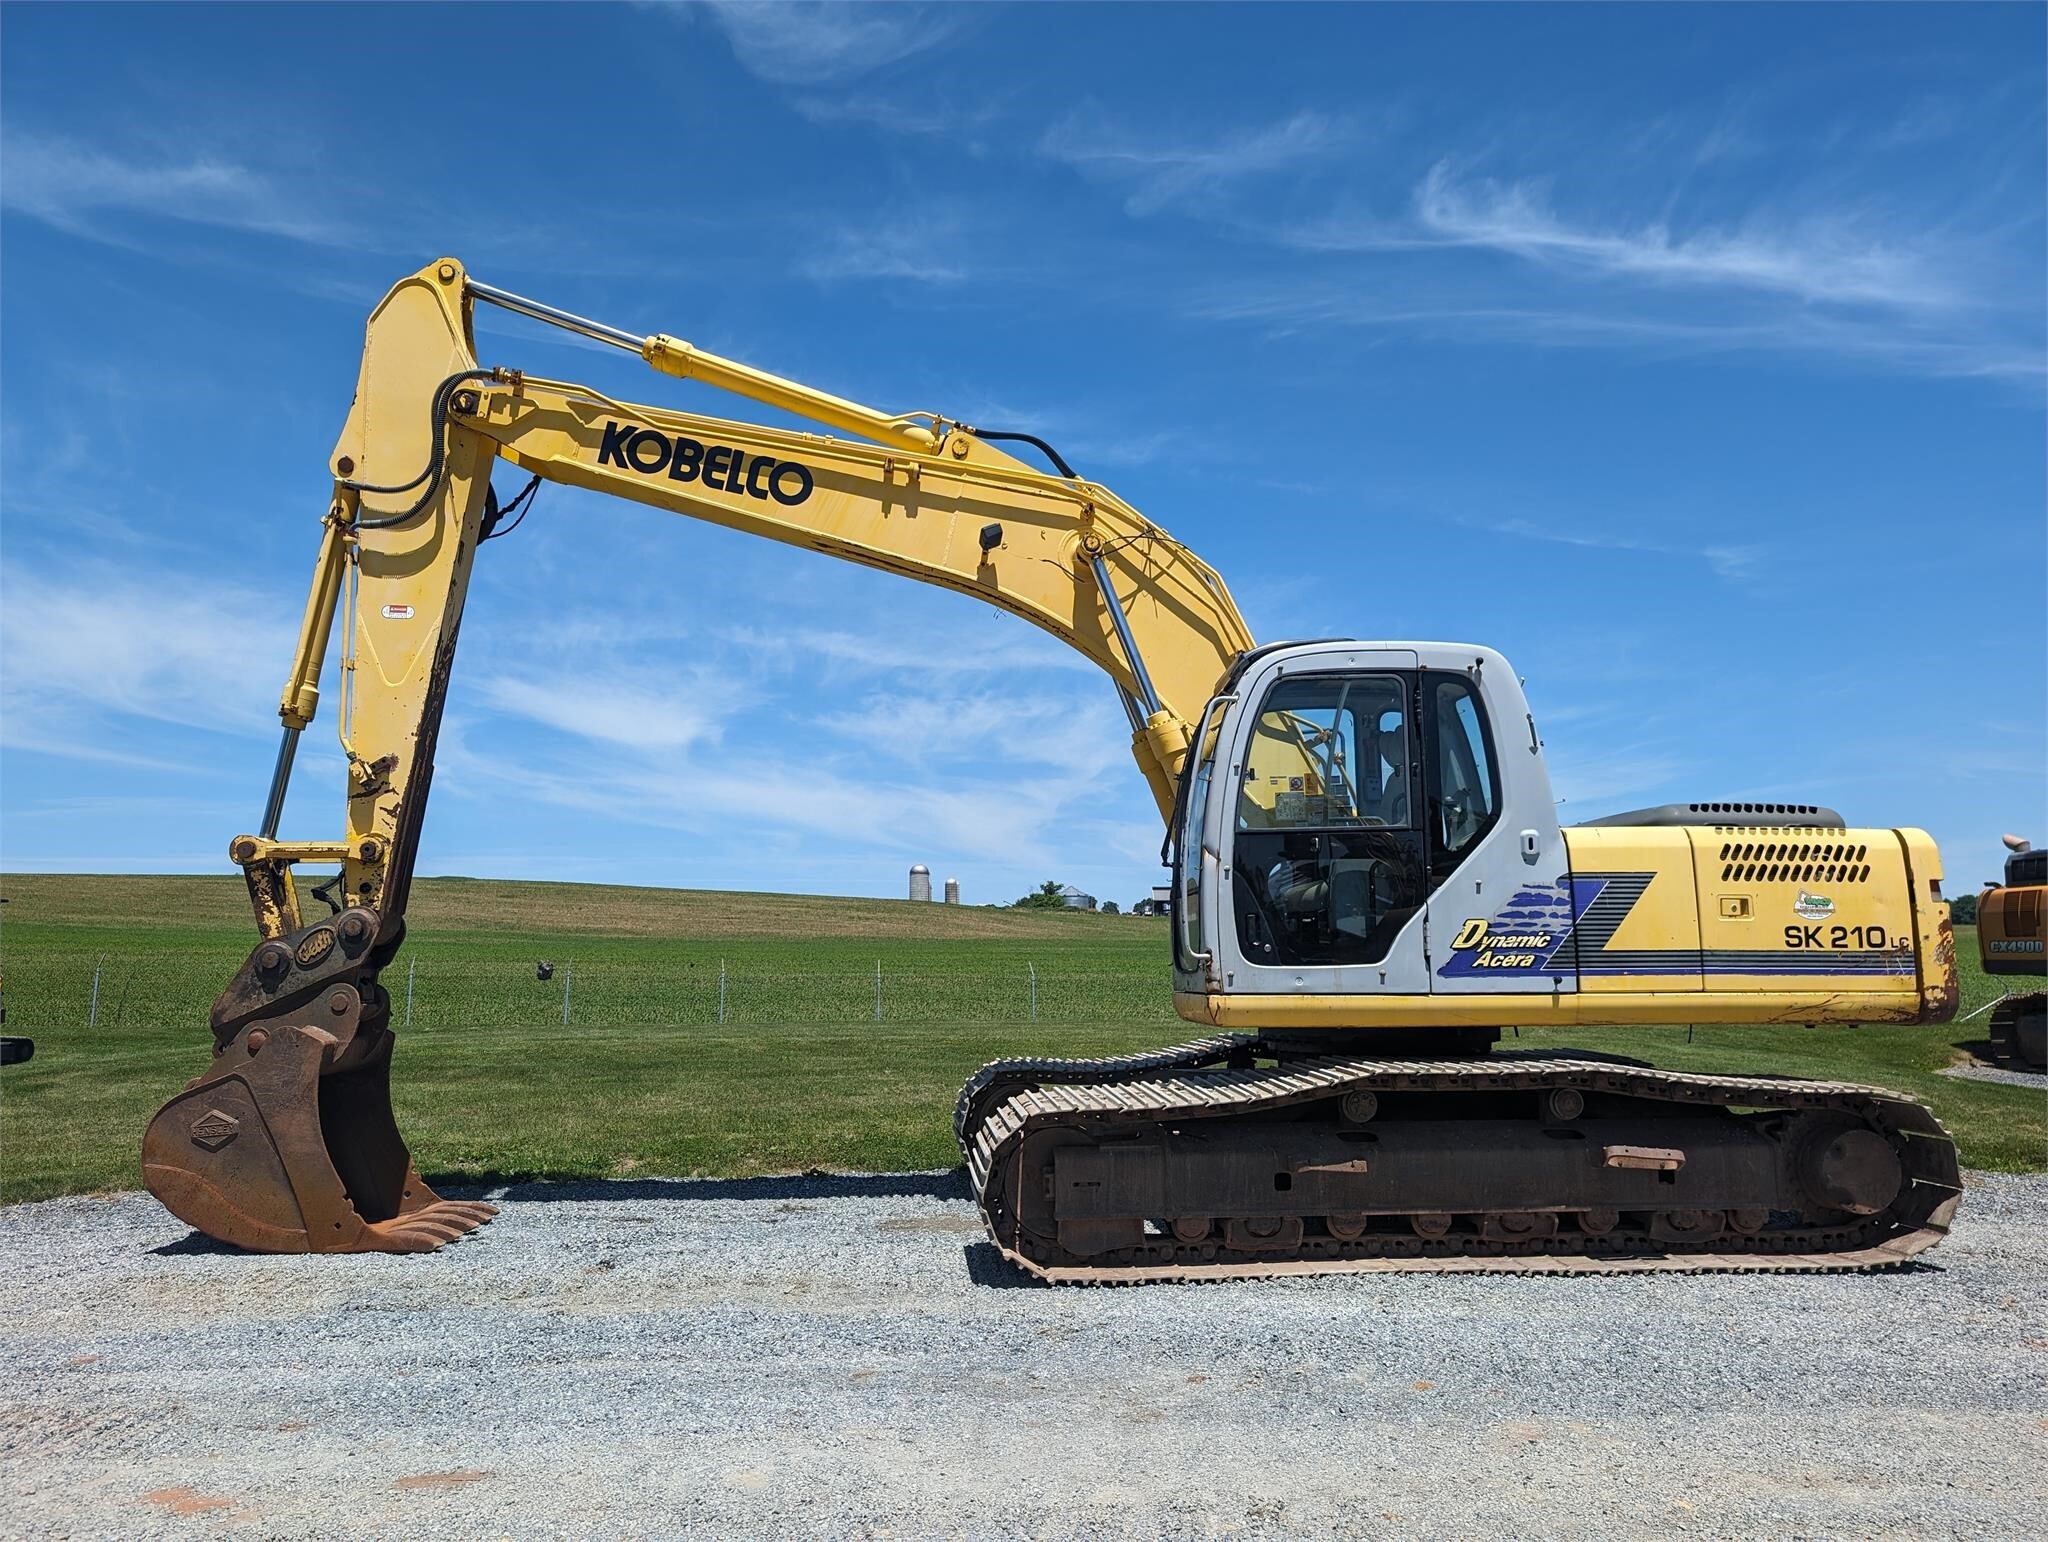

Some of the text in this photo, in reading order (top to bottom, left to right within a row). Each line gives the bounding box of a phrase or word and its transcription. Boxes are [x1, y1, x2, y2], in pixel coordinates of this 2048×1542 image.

[597, 420, 814, 506] KOBELCO
[1450, 919, 1552, 953] Dynamic
[1784, 925, 1910, 949] SK 210 LC
[1990, 940, 2043, 953] CX490D
[1472, 950, 1536, 968] Acera
